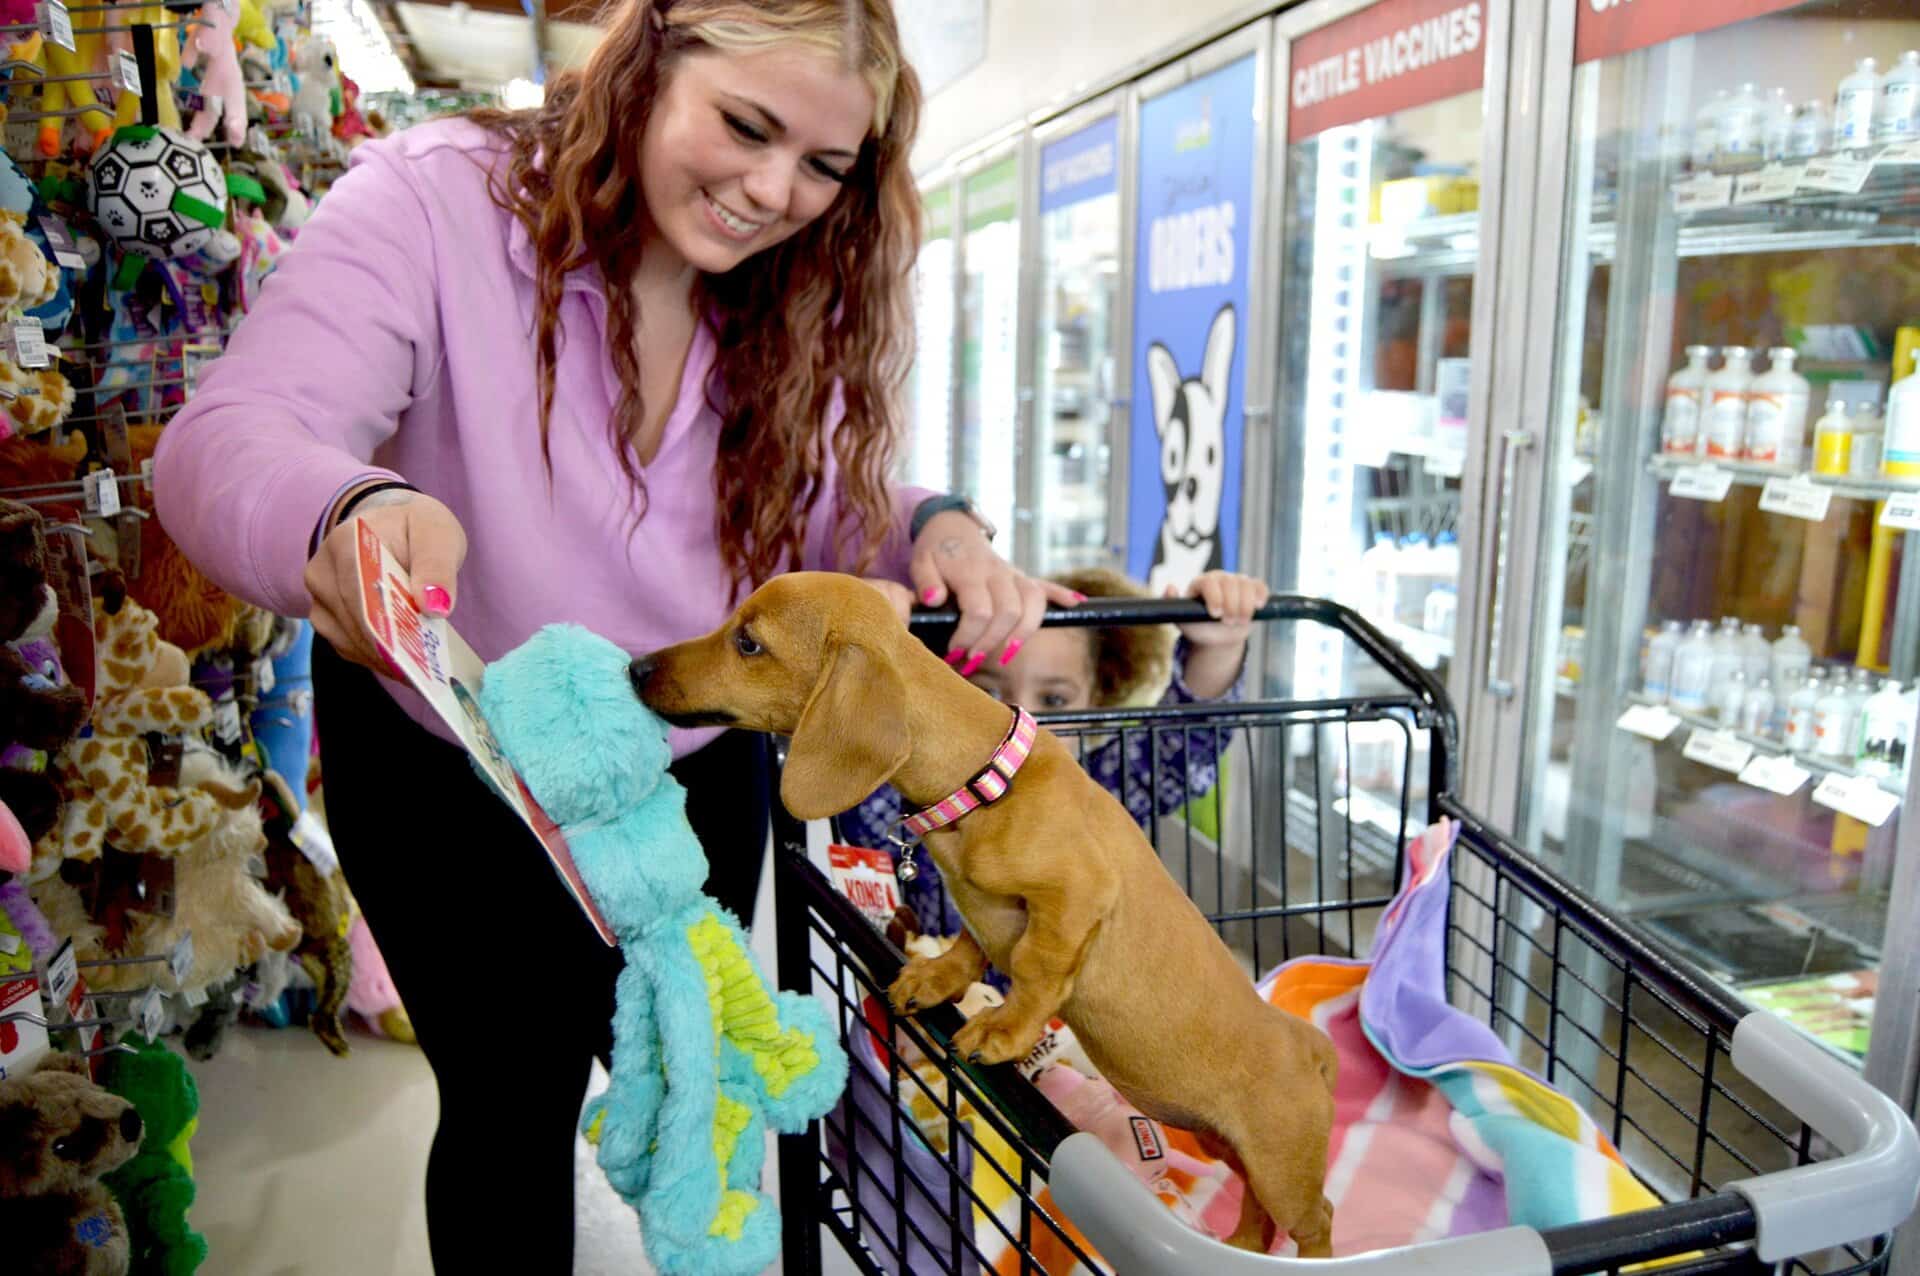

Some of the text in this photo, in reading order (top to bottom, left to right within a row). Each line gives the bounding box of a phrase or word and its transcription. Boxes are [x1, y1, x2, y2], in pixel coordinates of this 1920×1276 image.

[1292, 3, 1482, 109] CATTLE VACCINES
[390, 590, 432, 681] KONG
[844, 877, 884, 909] KONG
[1136, 1120, 1154, 1147] KONG
